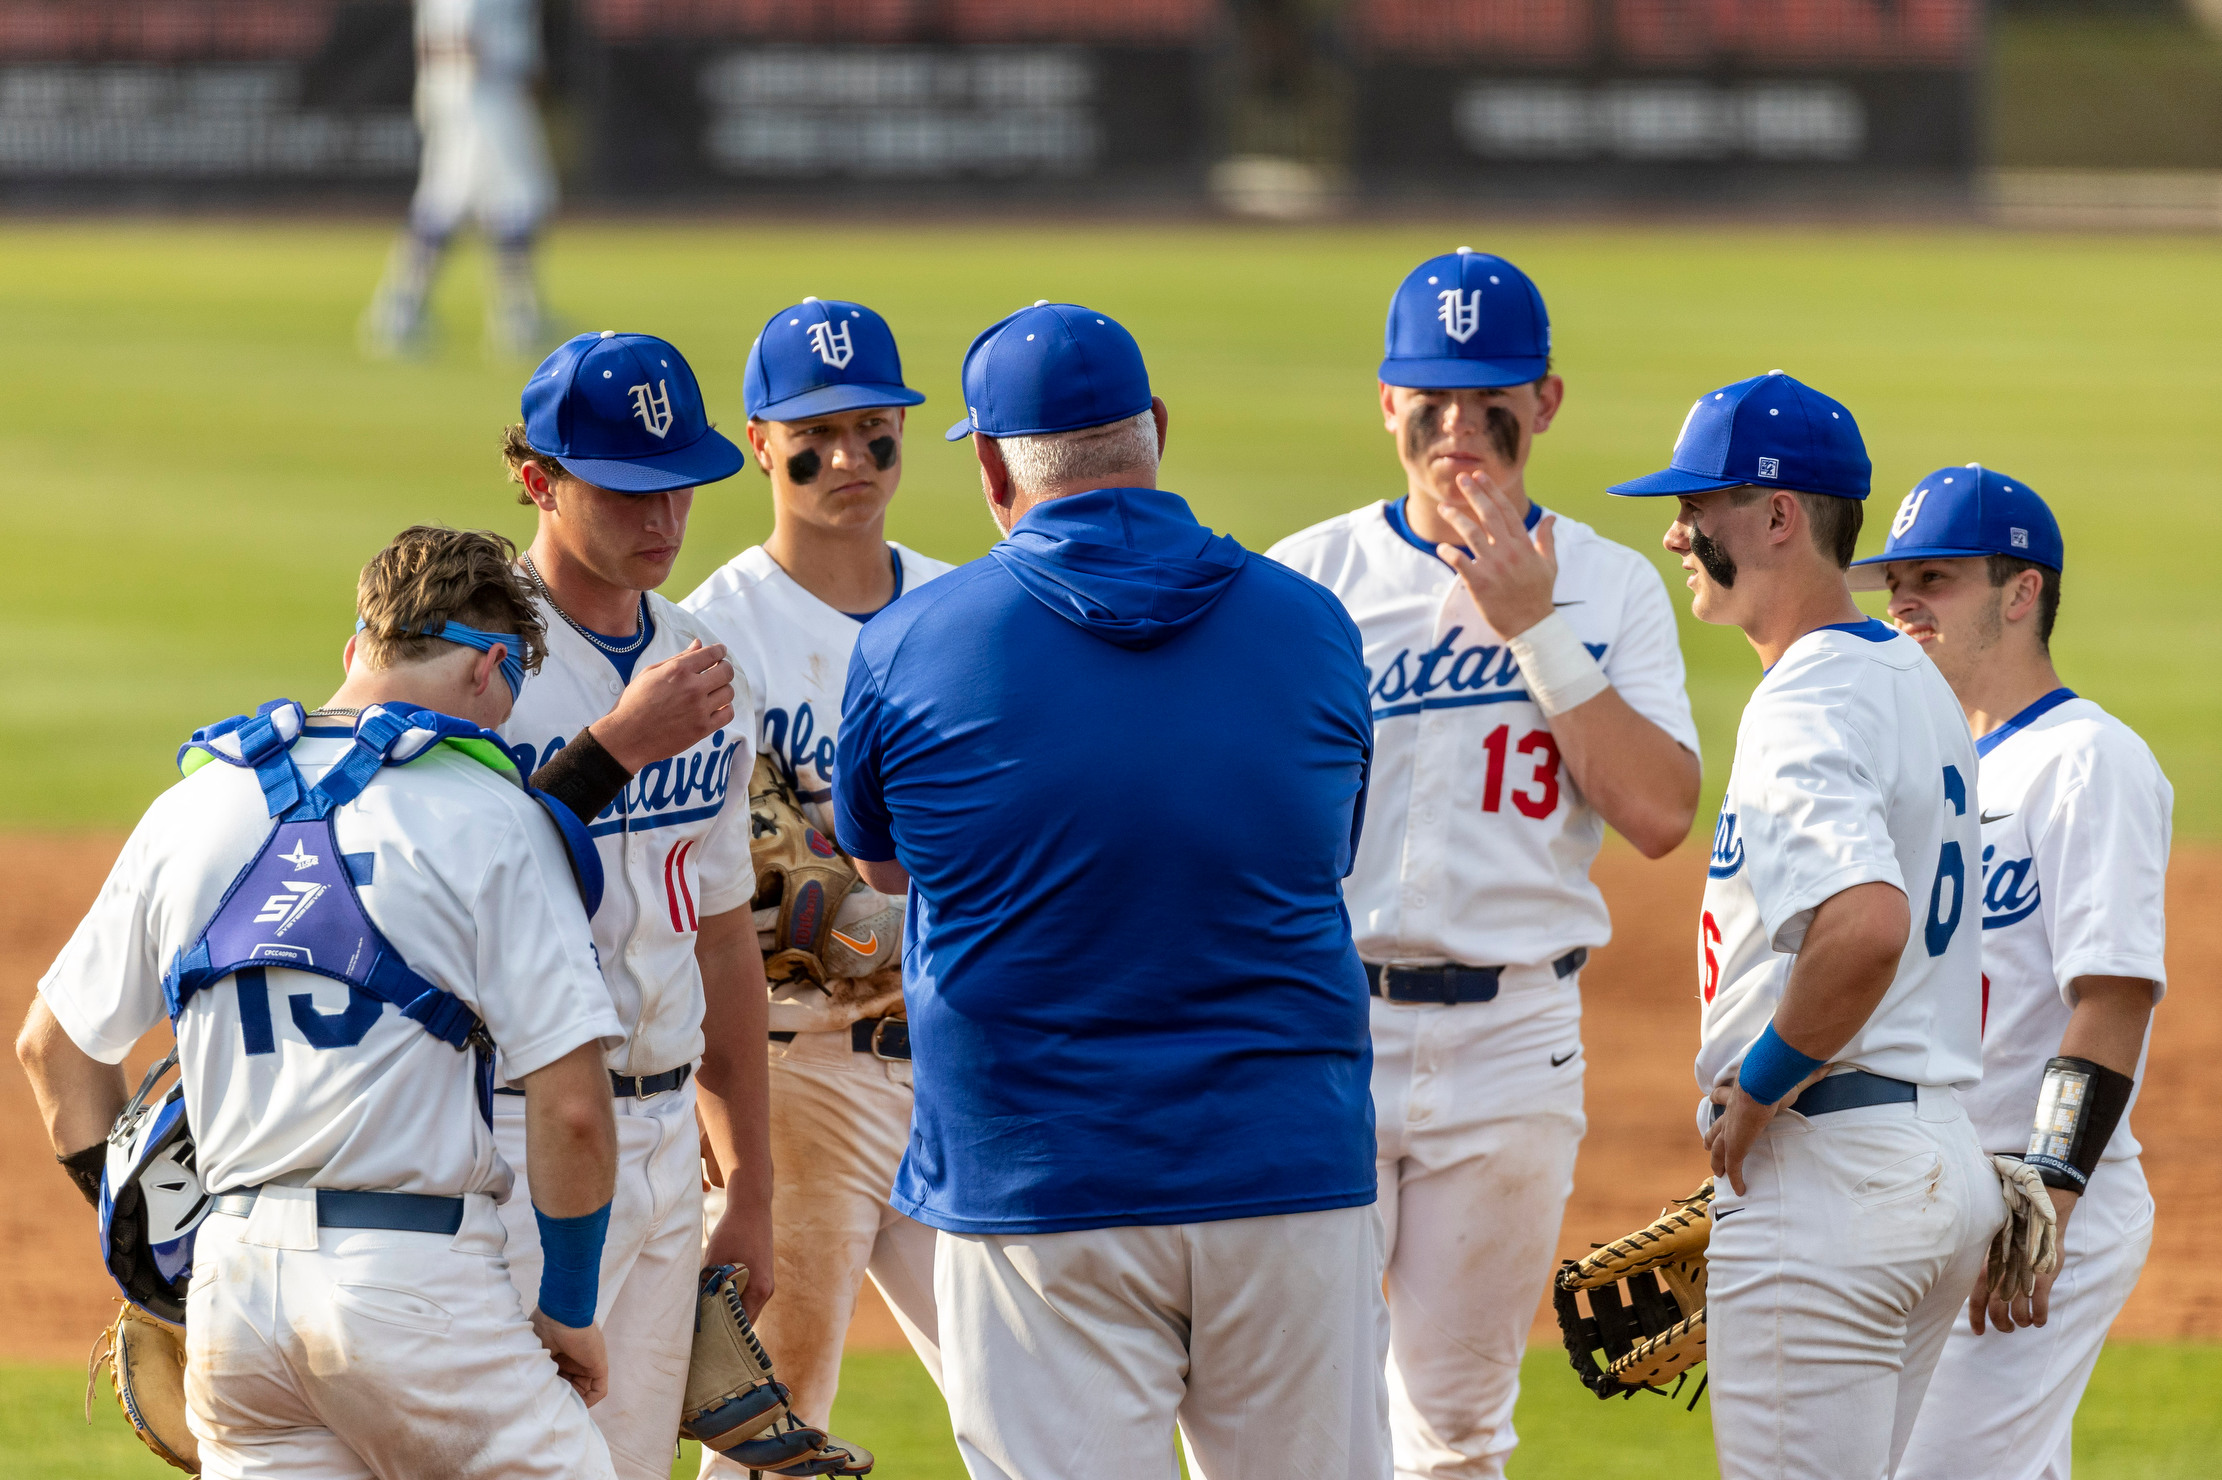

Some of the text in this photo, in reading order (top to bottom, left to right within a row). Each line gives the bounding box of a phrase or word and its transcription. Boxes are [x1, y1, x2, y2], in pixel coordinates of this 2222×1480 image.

[1481, 724, 1561, 820] 13
[664, 840, 699, 933] 11
[794, 884, 819, 947] Wilson
[1702, 909, 1723, 1006] 6
[122, 1384, 145, 1431] Wilson
